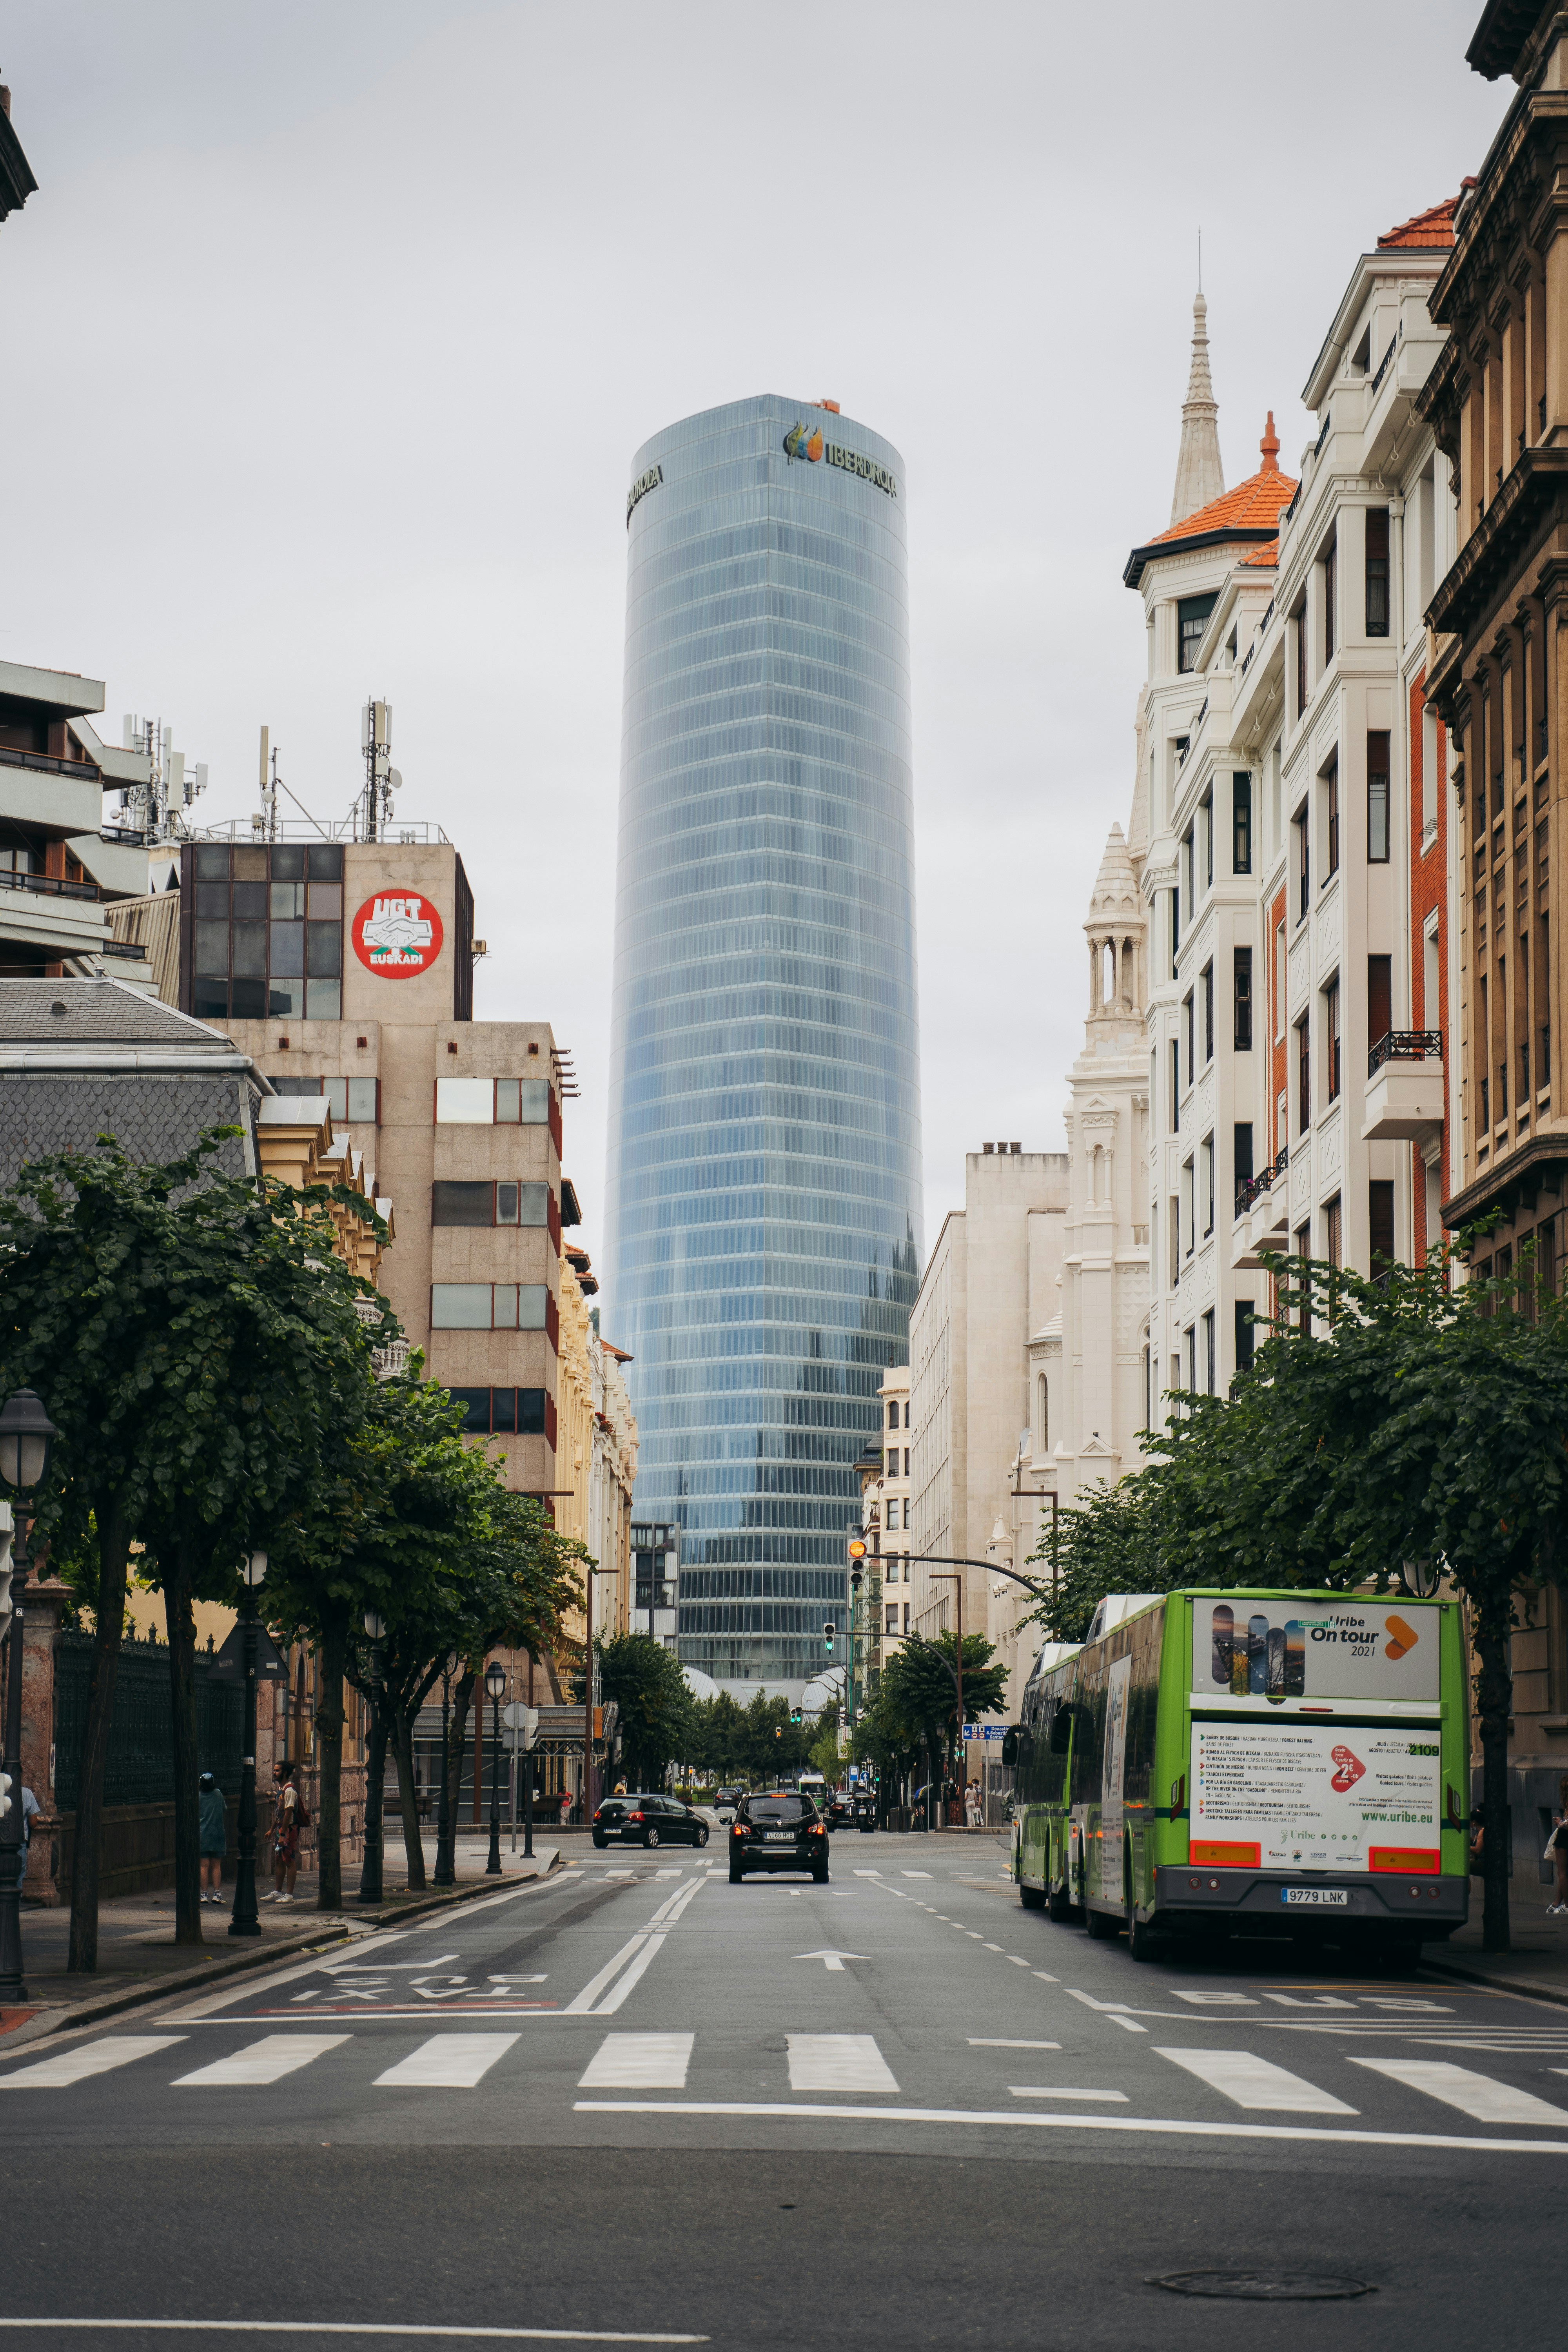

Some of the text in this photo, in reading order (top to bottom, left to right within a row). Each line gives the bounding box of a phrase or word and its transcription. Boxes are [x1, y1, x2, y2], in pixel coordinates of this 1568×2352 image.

[828, 443, 897, 493] IBERDROLA
[372, 898, 421, 920] UGT
[370, 954, 423, 964] EUSKADI
[1311, 1628, 1379, 1643] On tour
[1351, 1646, 1375, 1656] 2021
[1410, 1745, 1439, 1756] 2109
[1361, 1811, 1432, 1823] www.uribe.eu
[1290, 1830, 1315, 1839] Uribe
[1290, 1891, 1318, 1902] 9779
[1323, 1892, 1344, 1903] LNK
[332, 1974, 549, 1986] BUS
[289, 1986, 525, 2001] TAXI
[1169, 1990, 1457, 2012] BUS
